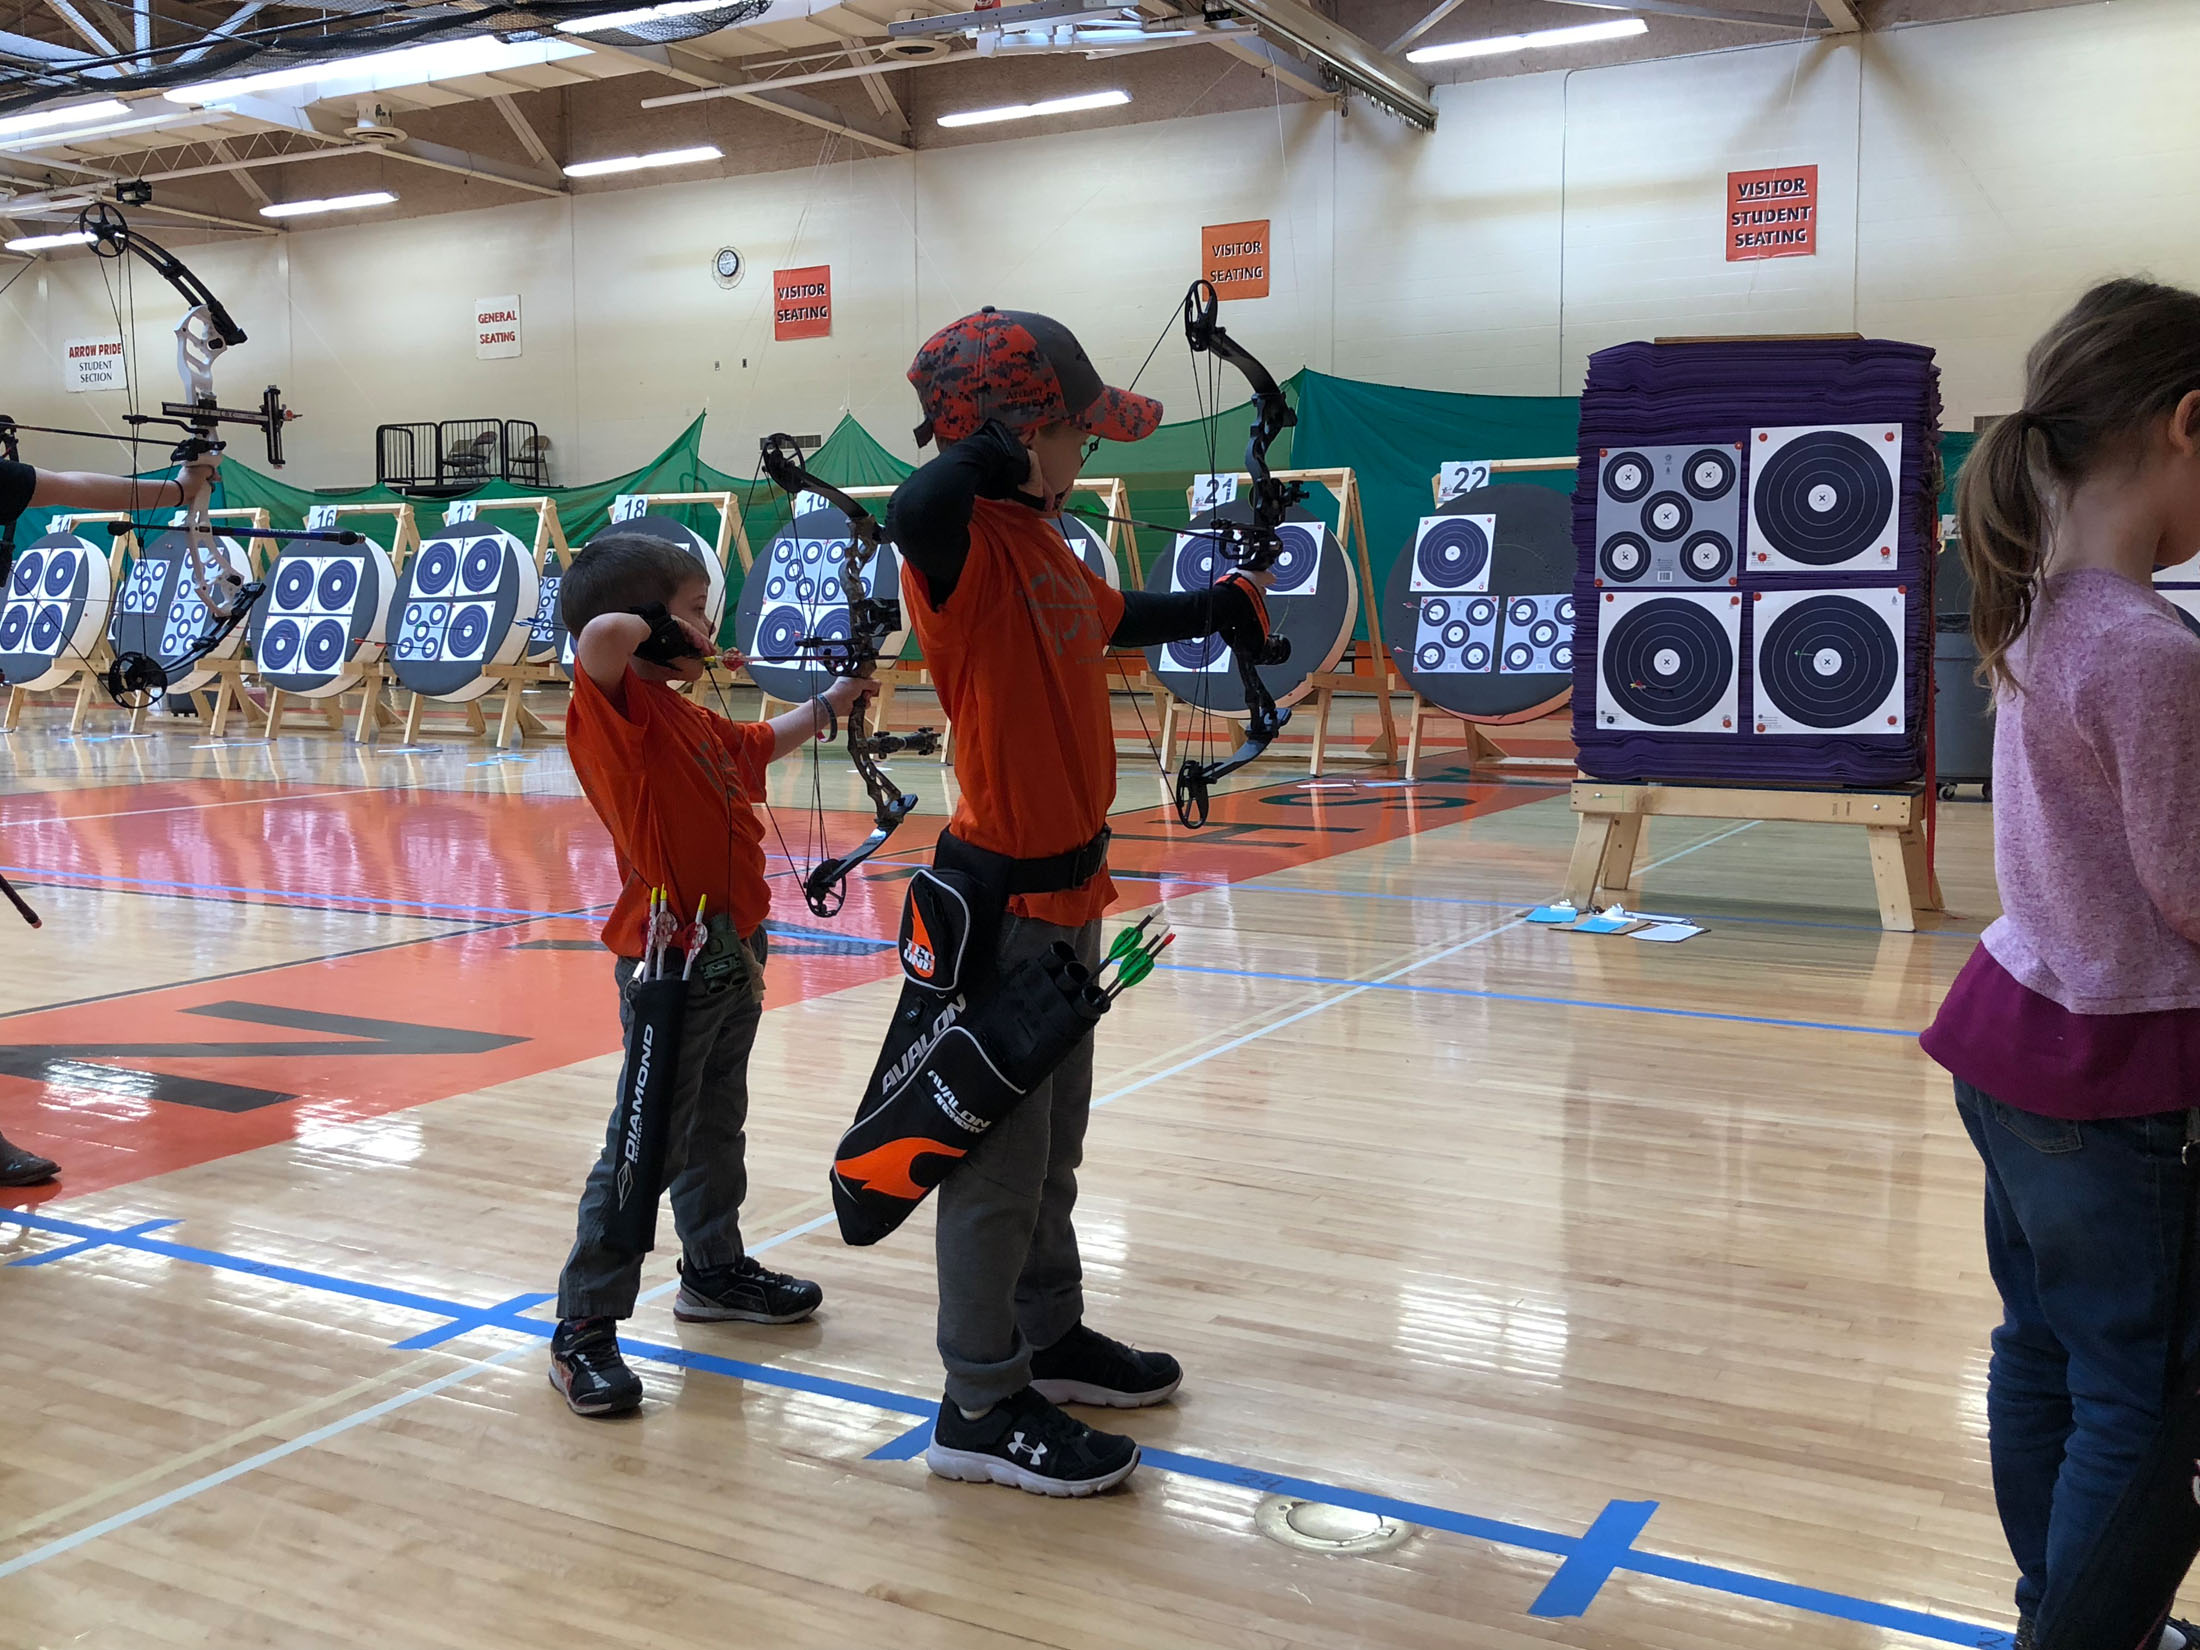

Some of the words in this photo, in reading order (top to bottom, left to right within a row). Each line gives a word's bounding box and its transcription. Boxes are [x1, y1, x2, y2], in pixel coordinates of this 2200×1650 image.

[1738, 178, 1807, 198] VISITOR
[1731, 206, 1812, 227] STUDENT
[1735, 228, 1808, 248] SEATING
[1212, 241, 1263, 258] VISITOR
[1210, 266, 1264, 283] SEATING
[777, 283, 827, 300] VISITOR
[478, 310, 517, 324] GENERAL
[777, 306, 829, 323] SEATING
[480, 331, 516, 344] SEATING
[69, 344, 97, 358] ARROW
[98, 343, 122, 355] PRIDE
[80, 360, 113, 371] STUDENT
[80, 373, 113, 383] SECTION
[1453, 466, 1487, 493] 22
[1204, 478, 1233, 504] 21
[317, 509, 335, 529] 16
[624, 499, 645, 520] 18
[882, 993, 967, 1096] AVALON
[625, 1023, 654, 1162] DIAMOND
[927, 1069, 992, 1129] AVALON
[634, 1119, 643, 1165] ARCHERY
